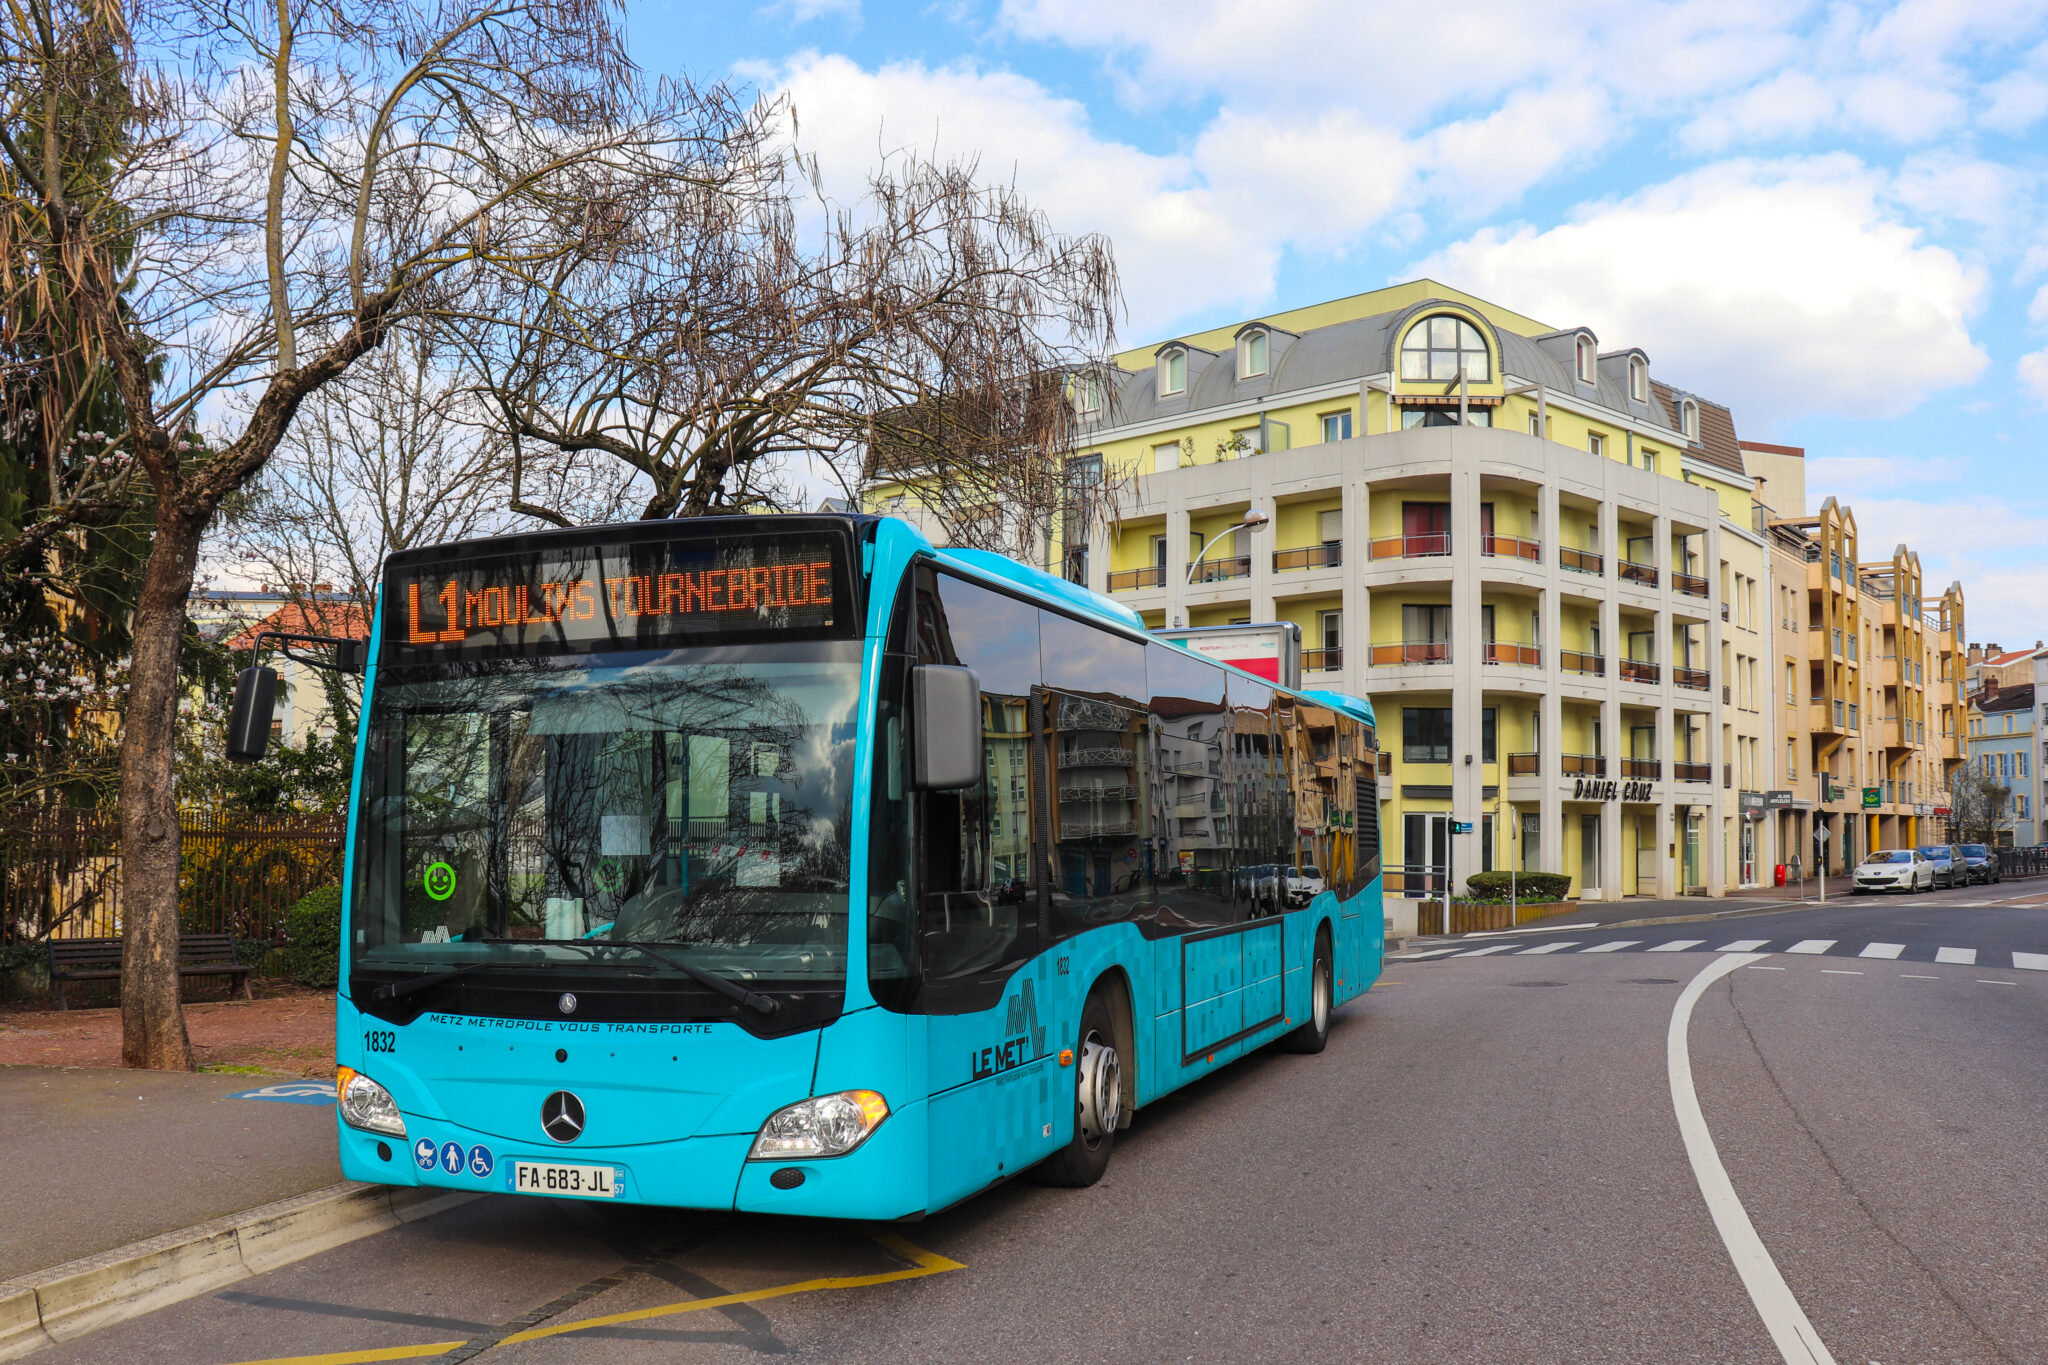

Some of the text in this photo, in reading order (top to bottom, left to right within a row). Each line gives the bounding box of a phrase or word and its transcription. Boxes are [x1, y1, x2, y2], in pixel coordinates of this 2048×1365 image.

[408, 562, 832, 644] L1 MOULINS TOURNEBRIDE
[1574, 779, 1653, 801] DANIEL CRUZ
[1057, 956, 1070, 977] 1832
[430, 1014, 713, 1034] METZ METROPOLE VOUS TRANSPORTE
[364, 1030, 396, 1054] 1832
[972, 1046, 993, 1081] LE
[519, 1166, 610, 1193] FA-683-JL
[614, 1183, 625, 1194] 57
